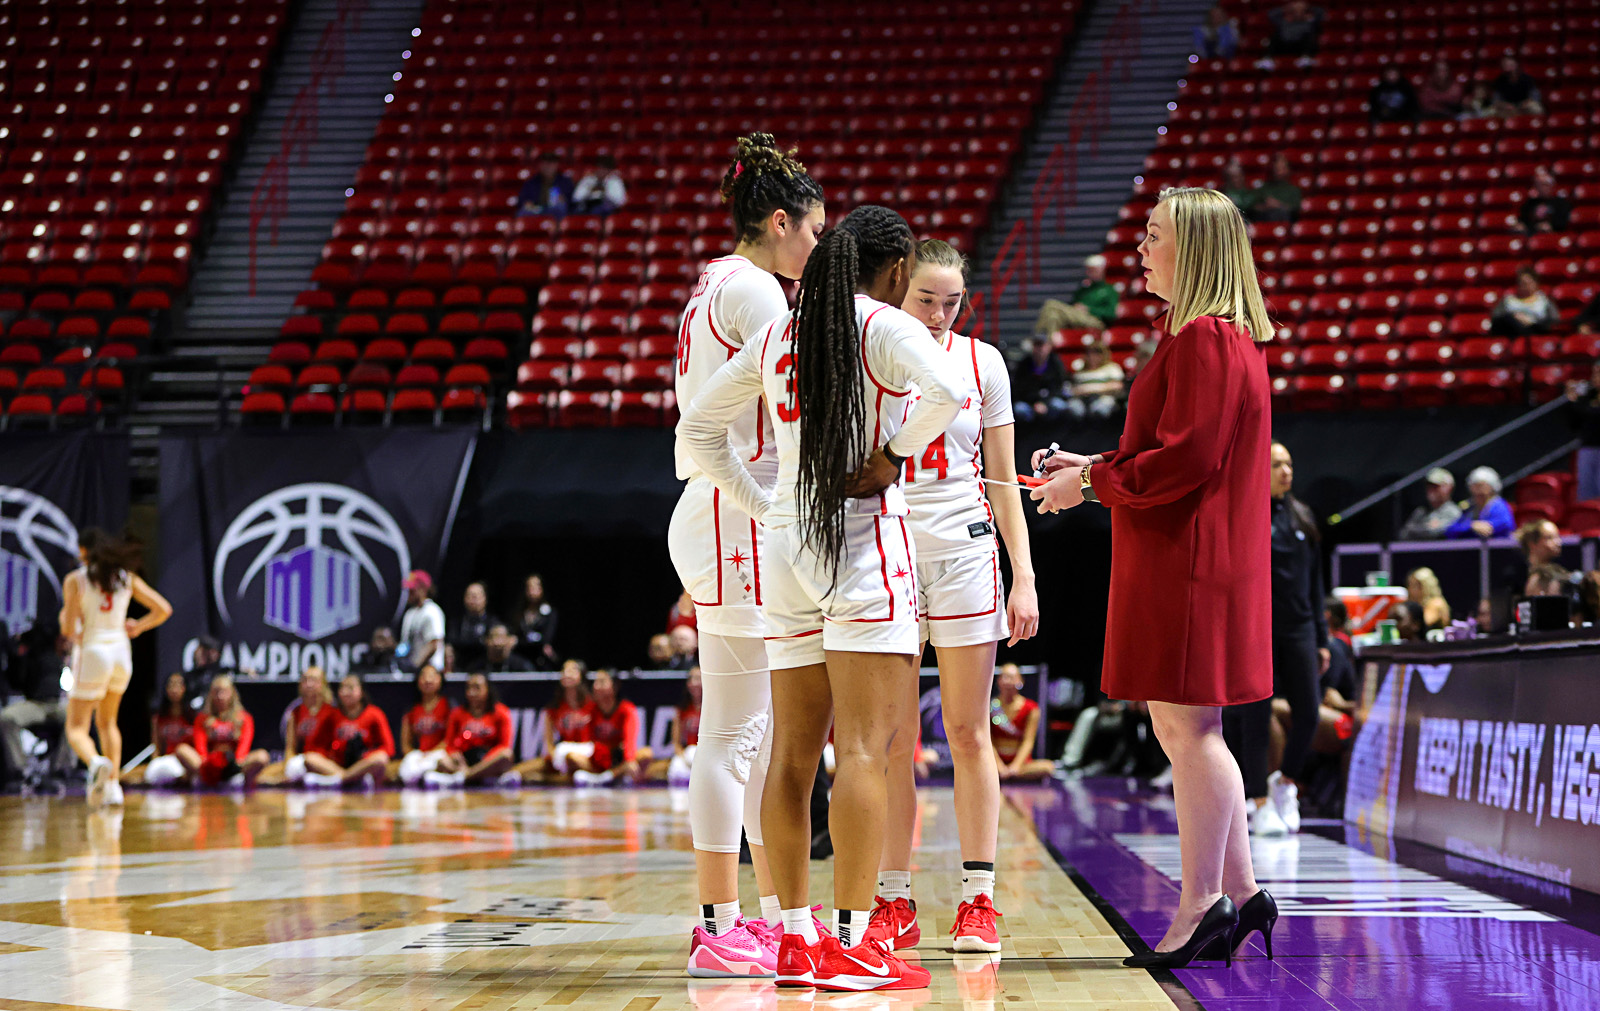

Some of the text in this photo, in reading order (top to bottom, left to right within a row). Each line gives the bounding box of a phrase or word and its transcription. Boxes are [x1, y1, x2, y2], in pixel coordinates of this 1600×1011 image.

[677, 306, 698, 376] 45
[775, 353, 801, 423] 3
[1550, 723, 1600, 826] VEG
[838, 925, 850, 947] NIKE
